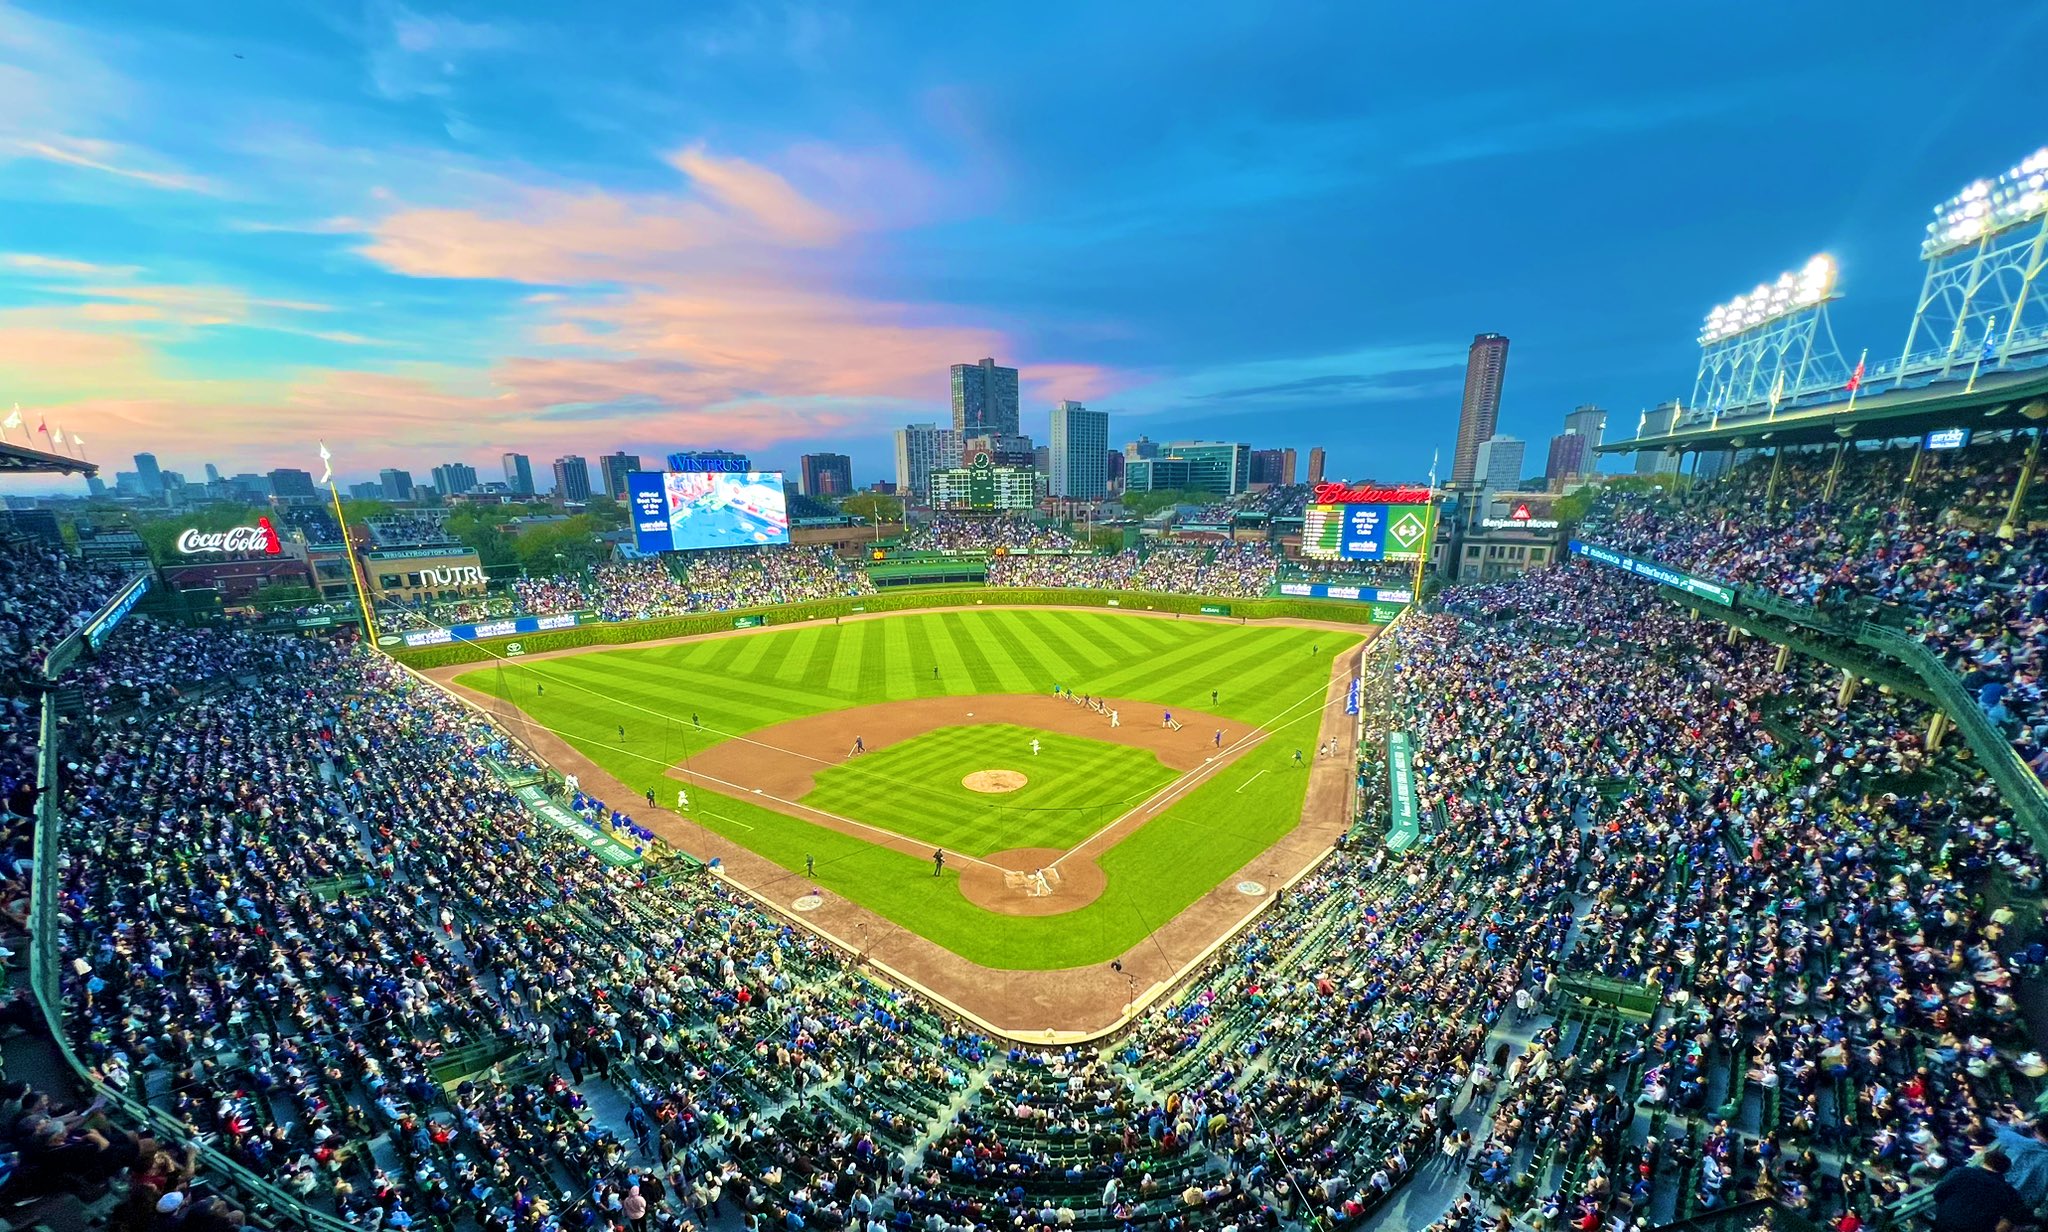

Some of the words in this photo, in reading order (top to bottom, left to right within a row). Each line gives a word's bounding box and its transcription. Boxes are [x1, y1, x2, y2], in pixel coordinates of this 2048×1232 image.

[668, 454, 750, 472] WINTRUST
[1314, 483, 1431, 504] Budweiser
[1398, 525, 1417, 537] 6-3
[1482, 518, 1525, 529] Benjamin
[1526, 519, 1559, 529] Moore
[177, 526, 268, 553] Coca-Cola
[540, 805, 577, 827] CHICAGO
[568, 822, 598, 840] CUBS
